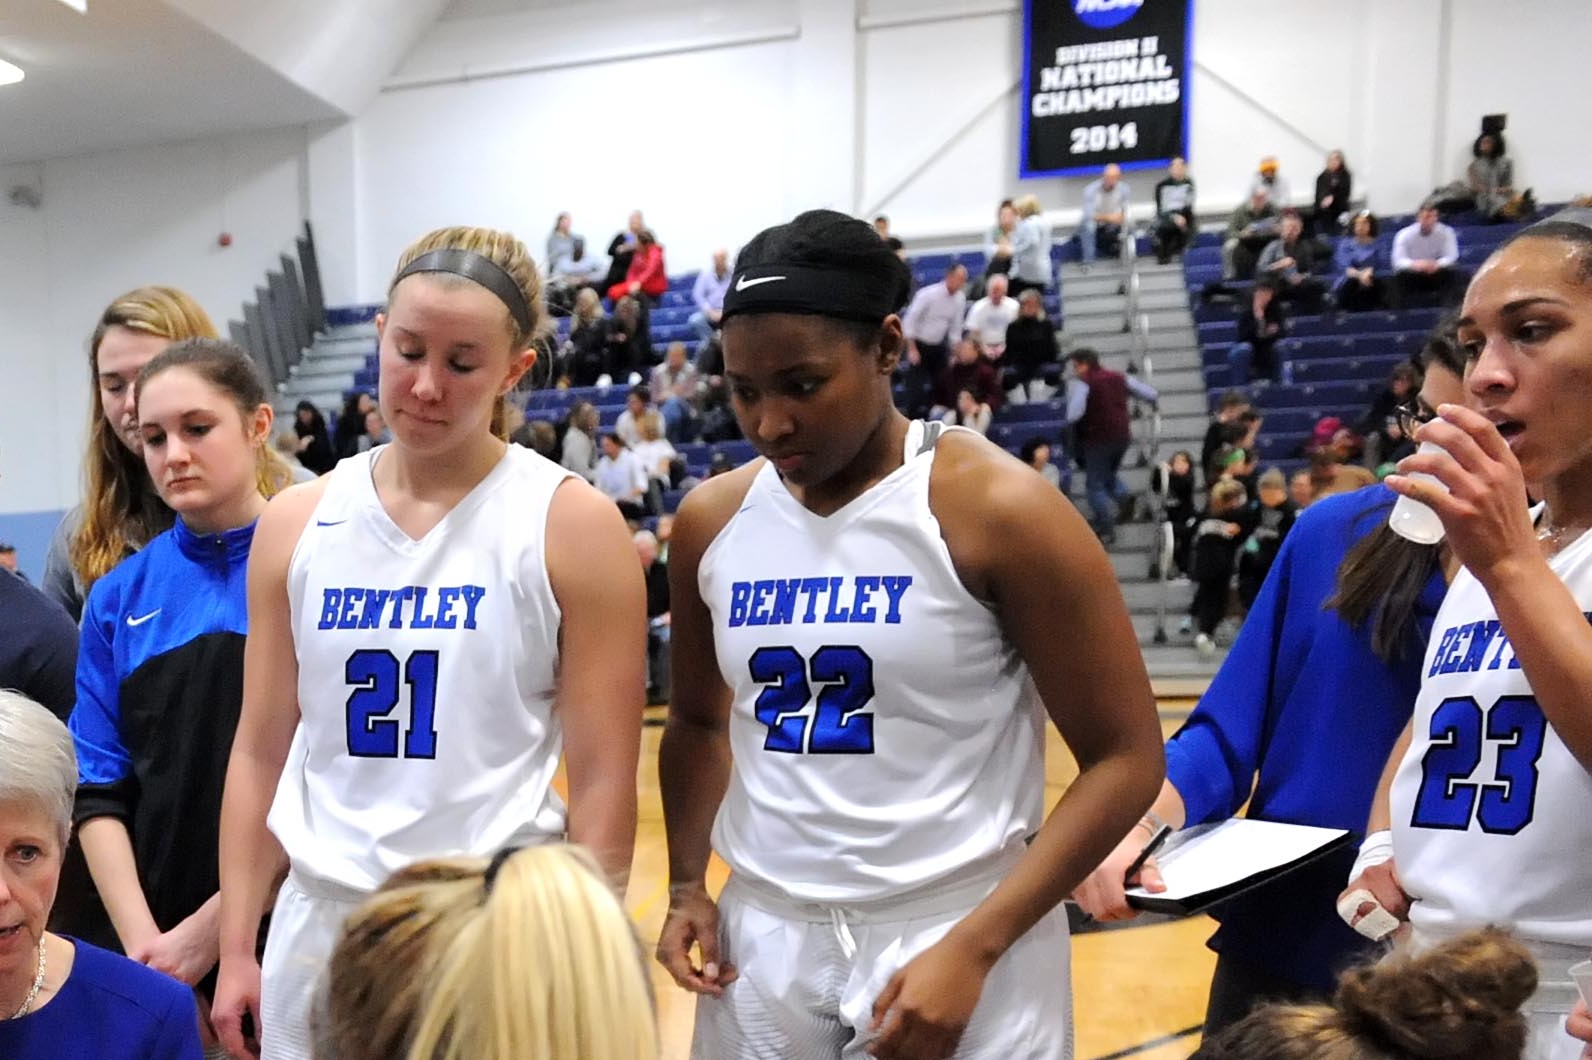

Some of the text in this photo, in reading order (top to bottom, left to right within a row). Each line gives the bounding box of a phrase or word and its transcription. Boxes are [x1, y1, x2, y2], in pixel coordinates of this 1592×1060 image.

[1040, 54, 1172, 91] NATIONAL
[1056, 38, 1139, 66] DIVISION
[1032, 78, 1180, 117] CHAMPIONS
[1069, 121, 1138, 154] 2014
[318, 584, 486, 630] BENTLEY
[728, 576, 913, 628] BENTLEY
[1428, 620, 1523, 678] BENT
[345, 649, 440, 760] 21
[748, 645, 876, 755] 22
[1410, 695, 1548, 836] 23
